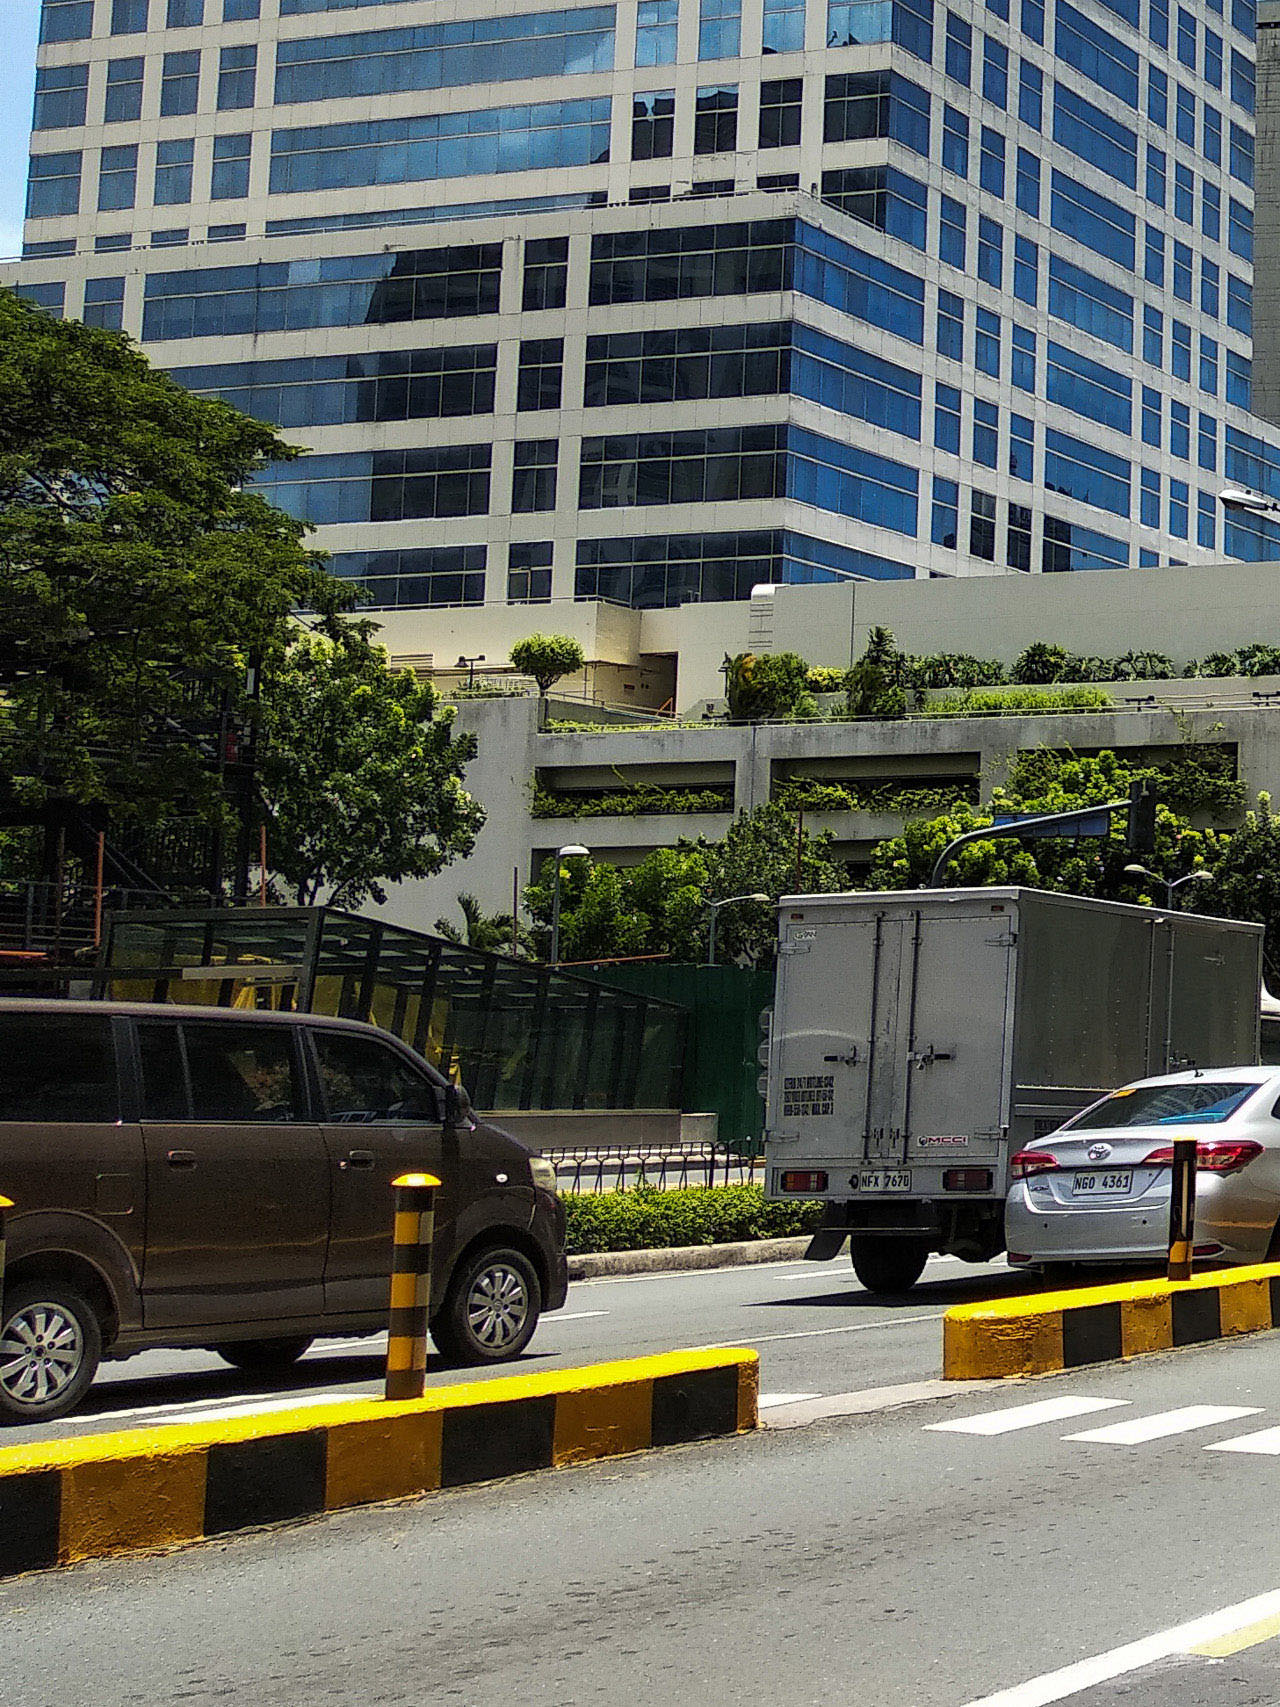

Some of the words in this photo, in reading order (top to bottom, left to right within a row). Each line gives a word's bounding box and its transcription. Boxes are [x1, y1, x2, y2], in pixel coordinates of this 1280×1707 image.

[927, 1136, 967, 1144] MCCI
[861, 1175, 879, 1187] NFX
[885, 1175, 909, 1187] 7670
[1074, 1176, 1095, 1190] NGO
[1102, 1175, 1130, 1189] 4361
